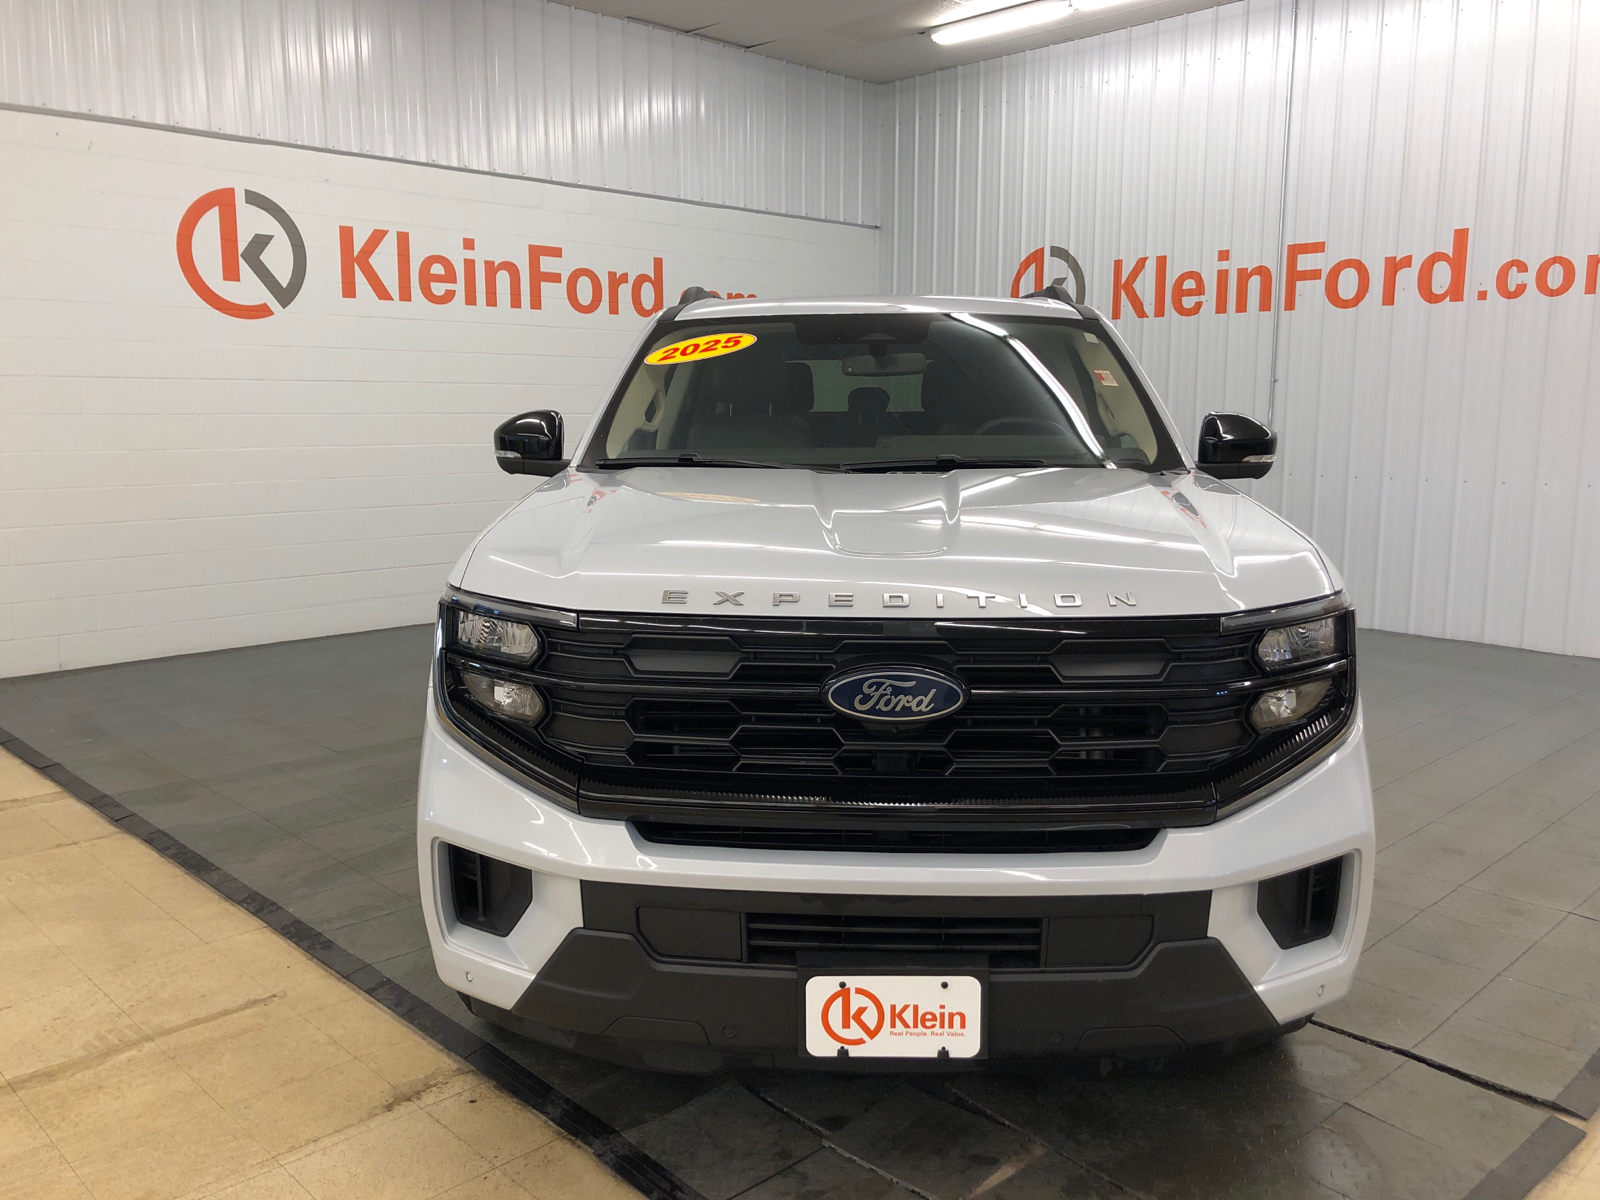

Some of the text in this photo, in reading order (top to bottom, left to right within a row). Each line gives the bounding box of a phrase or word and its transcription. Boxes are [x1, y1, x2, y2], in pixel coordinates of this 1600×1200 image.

[338, 225, 758, 318] KleinFord
[656, 335, 744, 363] 2025
[660, 588, 1138, 608] EXPEDITION
[853, 678, 936, 713] Ford
[889, 1004, 967, 1030] Klein
[905, 1030, 929, 1038] People.
